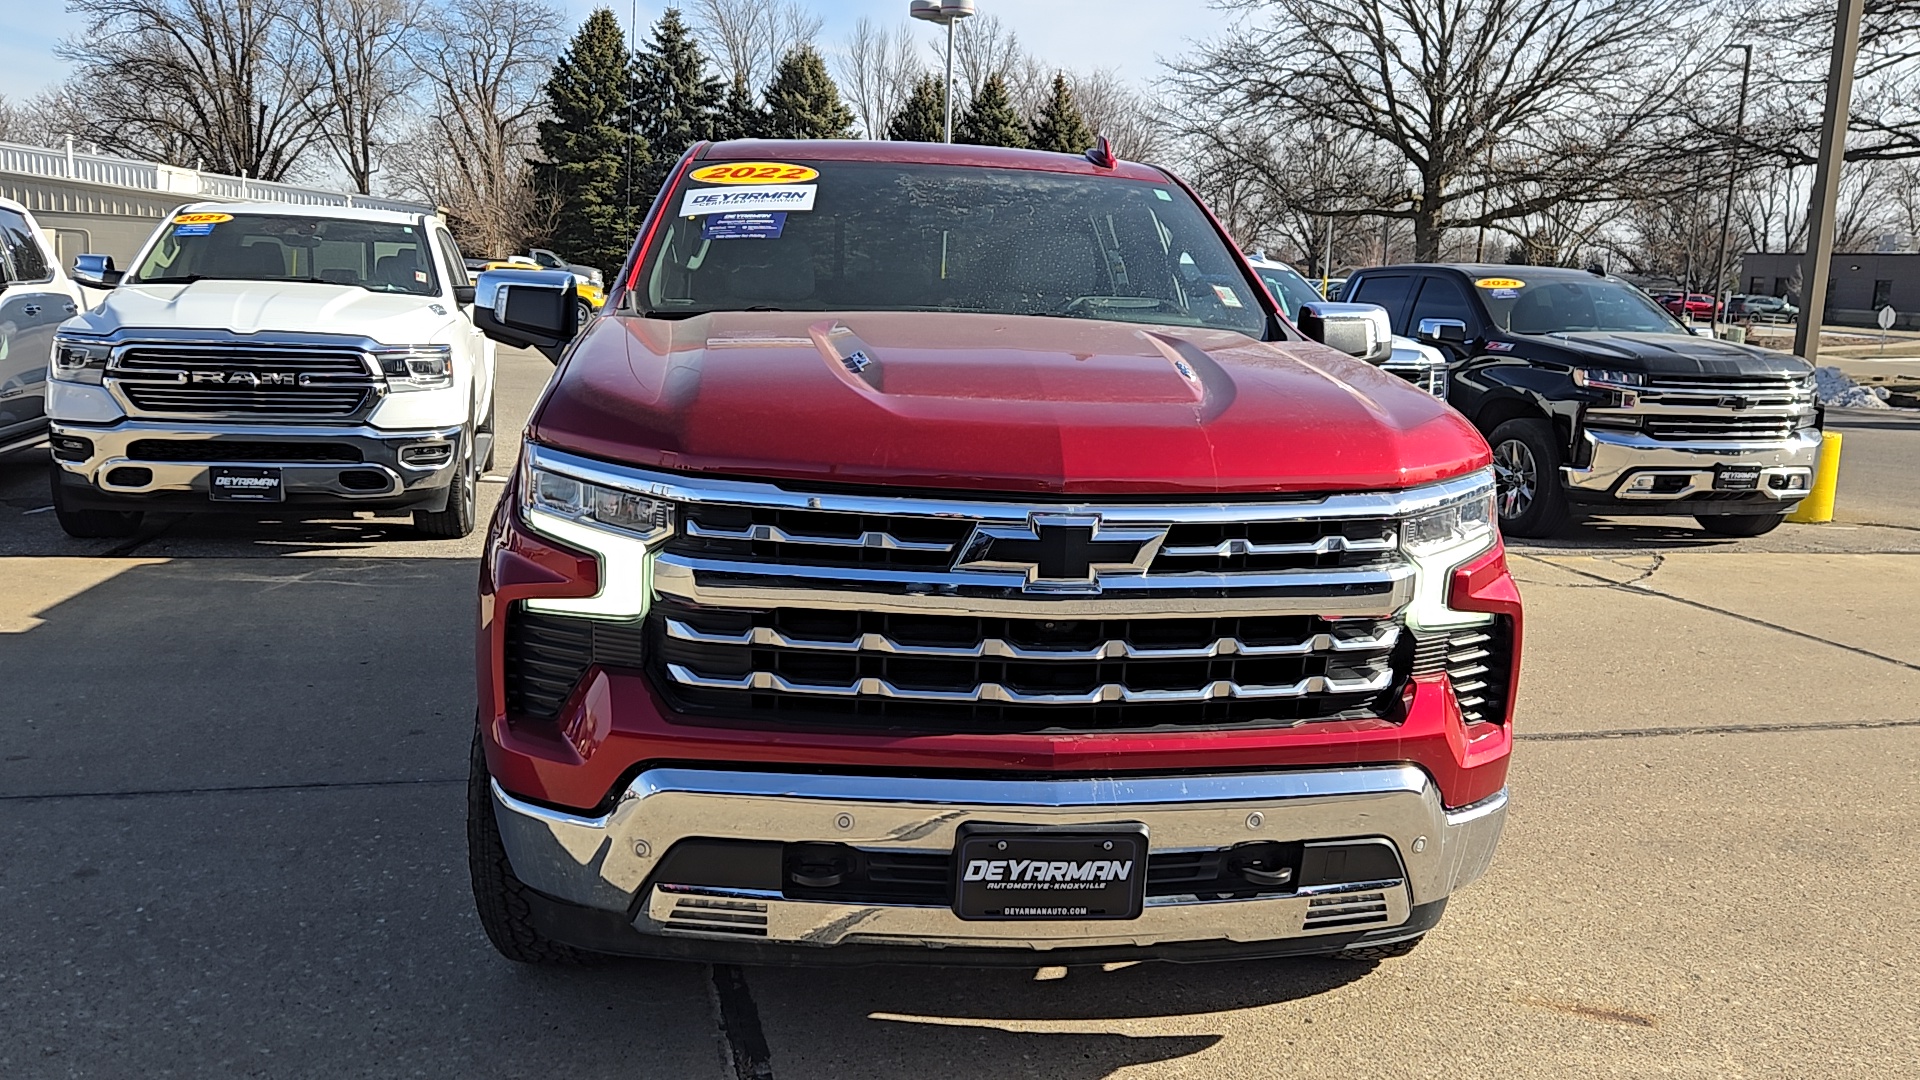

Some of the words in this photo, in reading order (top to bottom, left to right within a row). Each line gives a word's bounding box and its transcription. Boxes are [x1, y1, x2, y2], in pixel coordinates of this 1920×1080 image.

[702, 167, 808, 179] 2022
[692, 192, 807, 204] DEYARMAN
[177, 214, 225, 222] 2021
[192, 371, 295, 385] RAM
[215, 476, 279, 487] DEYARMAN
[963, 859, 1133, 882] DEYARMAN
[1004, 907, 1087, 916] DEYARMANAUTO.COM
